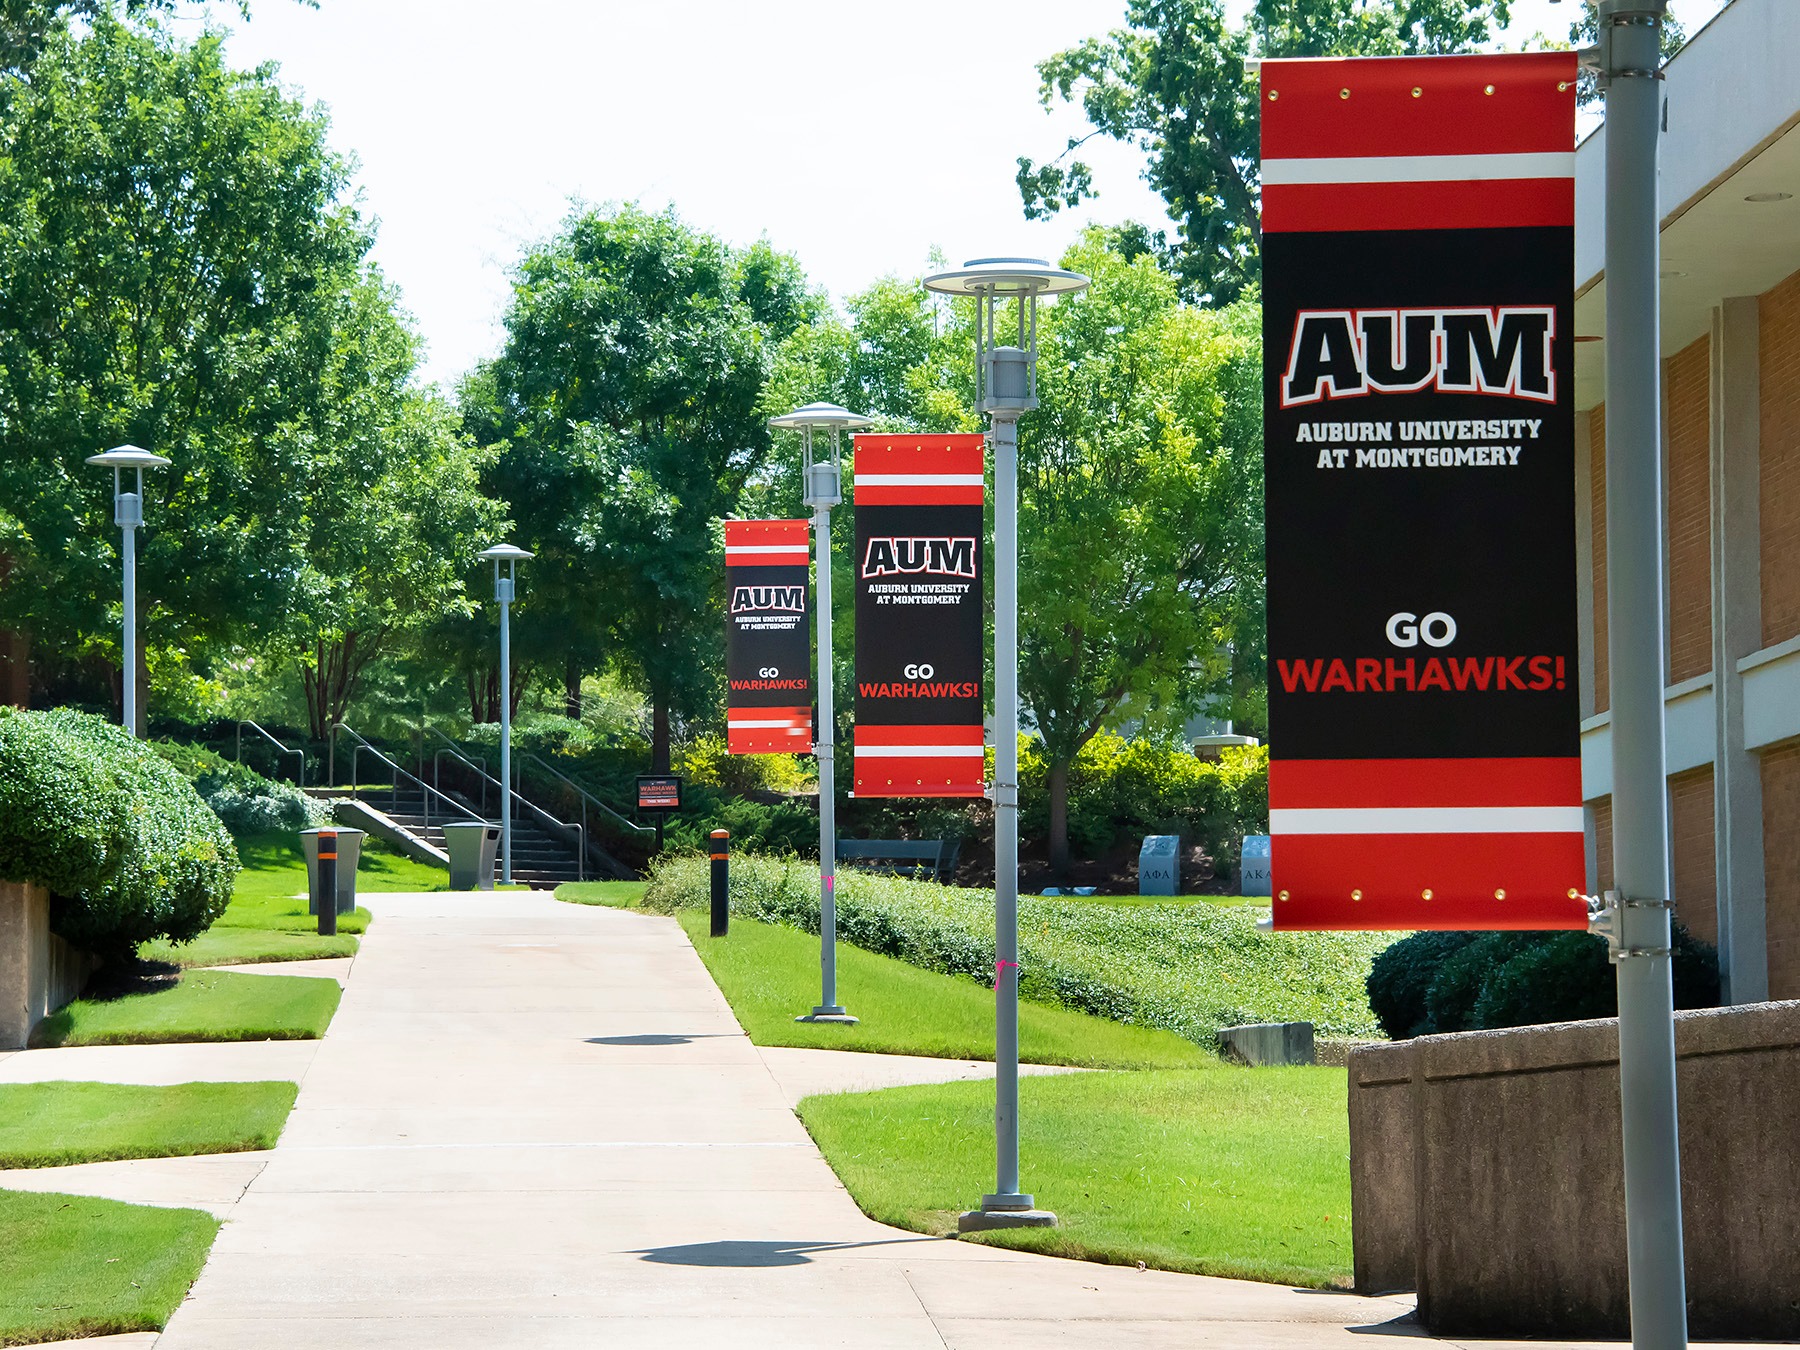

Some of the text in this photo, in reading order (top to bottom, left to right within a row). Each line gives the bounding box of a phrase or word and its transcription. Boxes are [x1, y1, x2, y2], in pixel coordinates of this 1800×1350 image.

[1280, 305, 1557, 410] AUM
[1296, 419, 1542, 443] AUBURN UNIVERSITY
[1316, 446, 1521, 469] AT MONTGOMERY
[862, 537, 976, 579] AUM
[731, 586, 805, 613] AUM
[868, 584, 970, 594] AUBURN UNIVERSITY
[876, 595, 962, 605] AT MONTGOMERY
[1385, 612, 1457, 648] GO
[759, 667, 779, 678] GO
[903, 663, 934, 680] GO
[1276, 656, 1566, 693] WARHAWKS!
[730, 679, 807, 690] WARHAWKS!
[859, 682, 979, 698] WARHAWKS!
